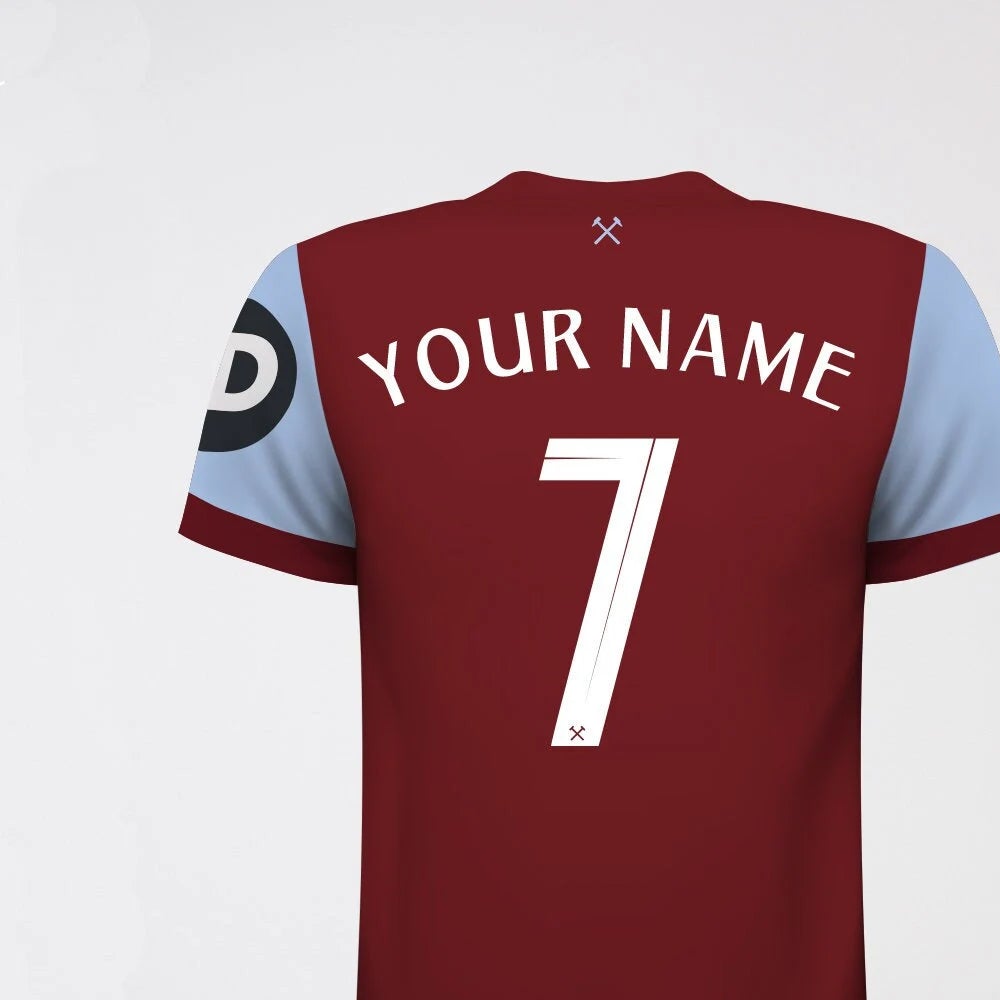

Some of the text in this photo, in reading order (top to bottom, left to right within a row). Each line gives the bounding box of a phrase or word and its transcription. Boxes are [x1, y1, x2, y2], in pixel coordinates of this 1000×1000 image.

[358, 306, 856, 411] YOUR NAME
[539, 438, 679, 746] 7
